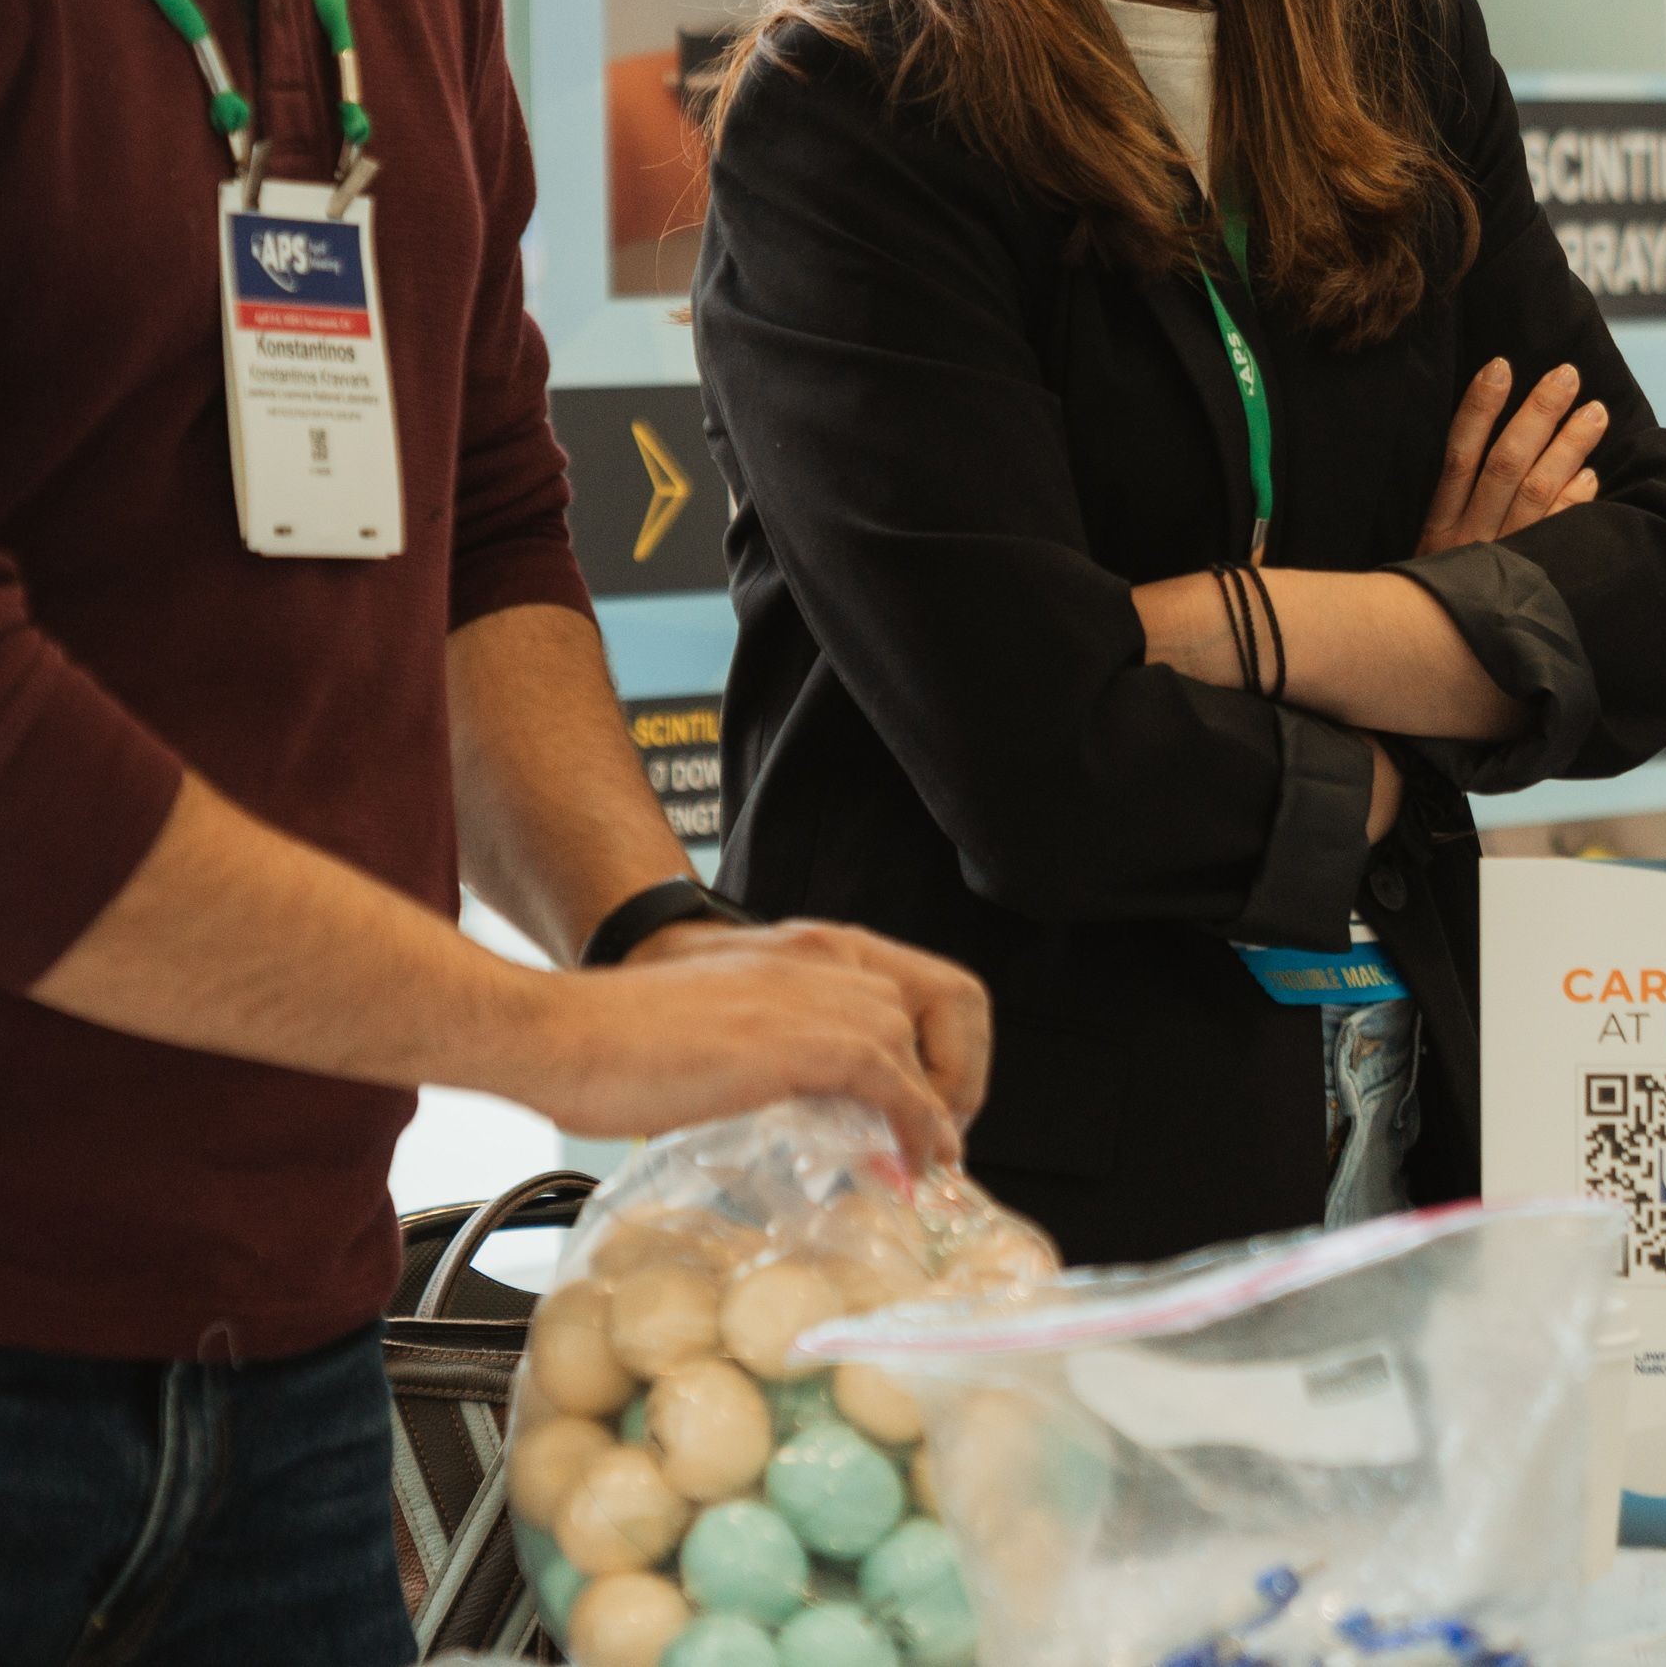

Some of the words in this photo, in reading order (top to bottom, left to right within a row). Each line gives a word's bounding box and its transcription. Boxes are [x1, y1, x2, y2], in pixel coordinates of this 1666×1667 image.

[262, 230, 309, 275] APS
[255, 332, 356, 364] Konstantinos
[1227, 332, 1255, 389] APS
[1598, 1013, 1649, 1045] AT
